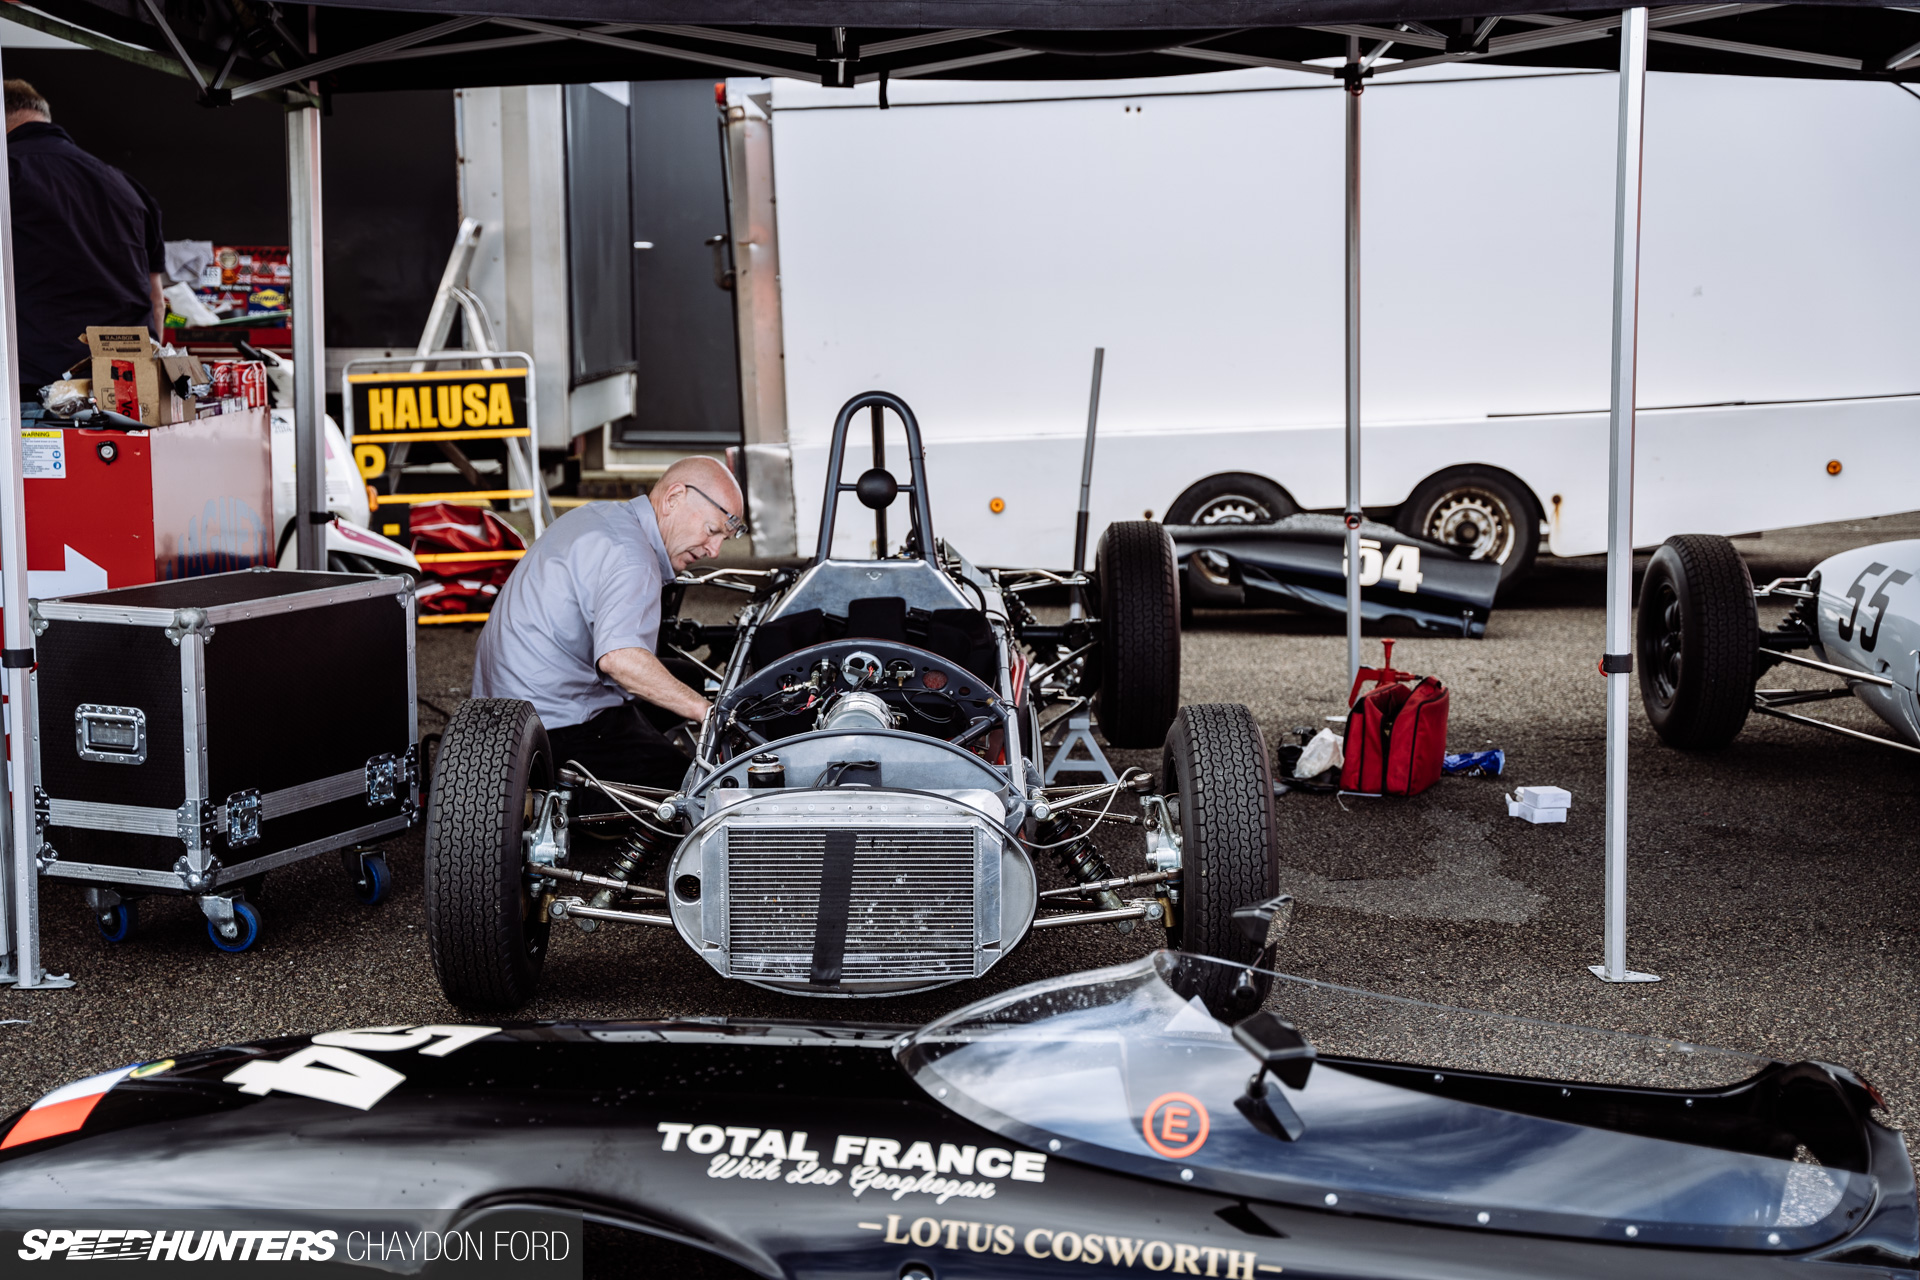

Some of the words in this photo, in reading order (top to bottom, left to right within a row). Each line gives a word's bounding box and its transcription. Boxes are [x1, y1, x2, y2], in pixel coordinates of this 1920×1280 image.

[368, 383, 515, 431] HALUSA
[1342, 536, 1424, 594] 54
[1838, 561, 1914, 653] 55
[222, 1024, 502, 1111] 54
[657, 1121, 819, 1161] TOTAL
[832, 1134, 1047, 1183] FRANCE
[1161, 1106, 1191, 1142] E
[707, 1153, 782, 1180] With
[785, 1160, 843, 1186] Leo
[848, 1164, 997, 1205] Geoghegan
